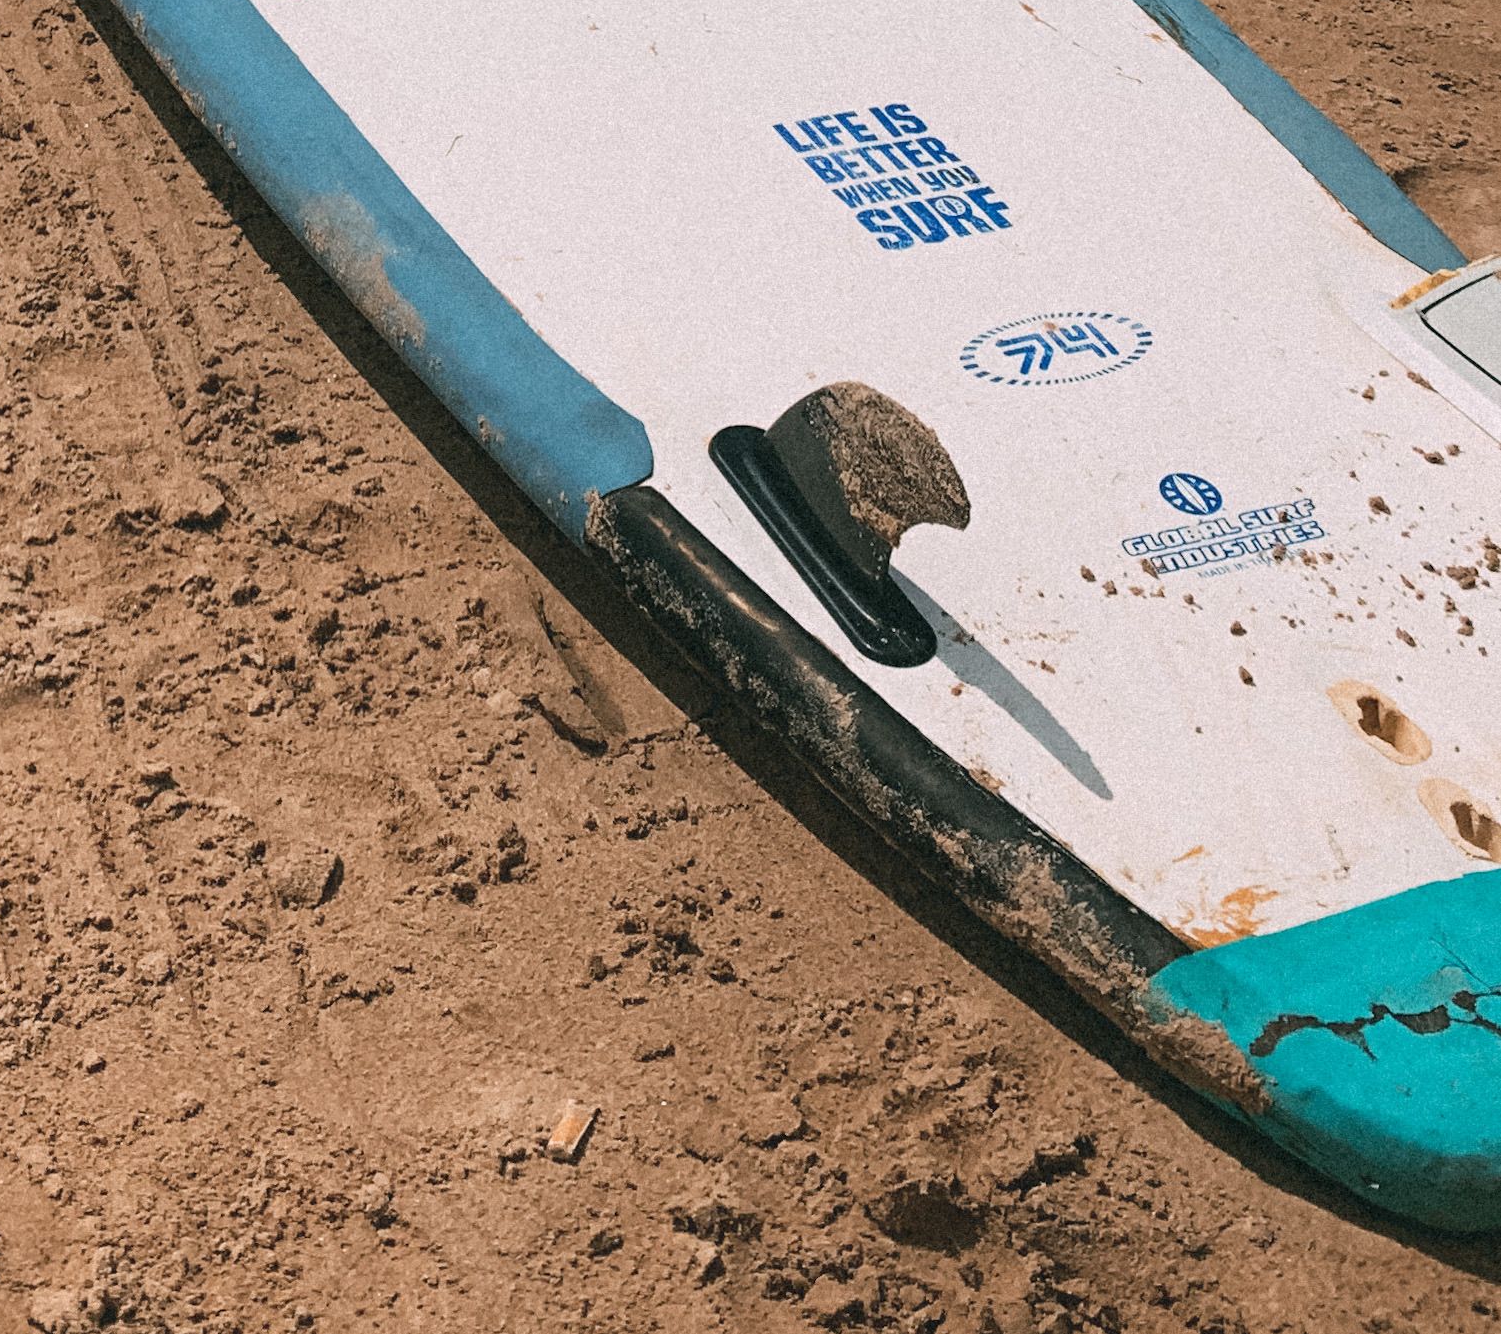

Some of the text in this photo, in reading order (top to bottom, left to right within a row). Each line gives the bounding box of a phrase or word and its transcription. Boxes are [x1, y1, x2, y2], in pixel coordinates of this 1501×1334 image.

[772, 102, 929, 154] LIFE IS
[803, 136, 961, 185] BETTER
[831, 165, 981, 210] WHEN YOU
[855, 186, 1014, 251] SURF
[1121, 498, 1317, 557] GLOBAL SURF
[1150, 520, 1325, 574] INDUSTRIES
[1198, 565, 1231, 579] MADE
